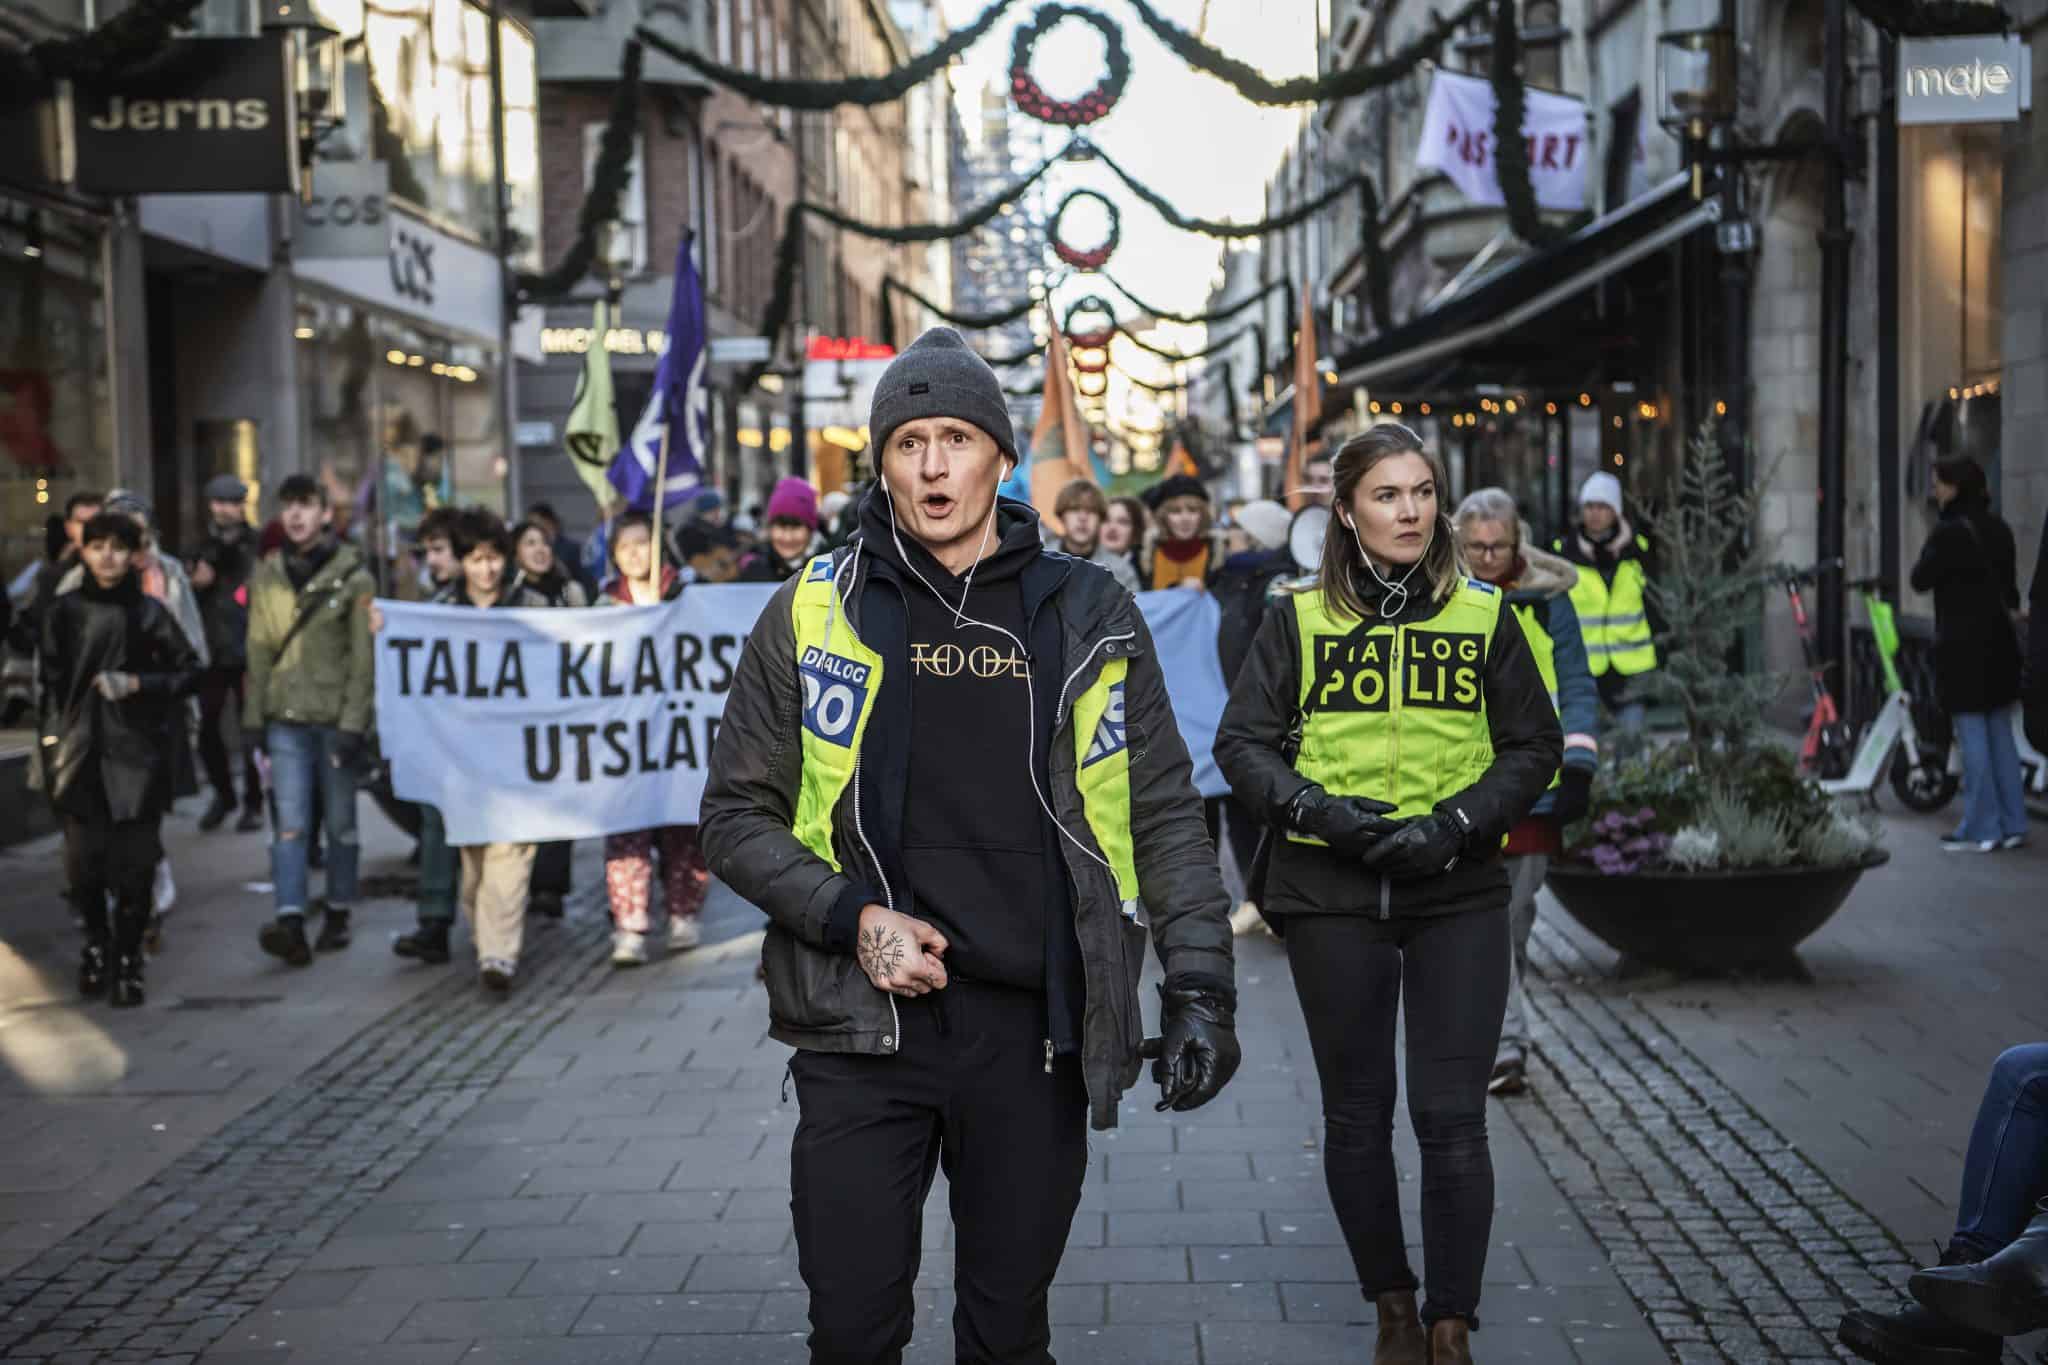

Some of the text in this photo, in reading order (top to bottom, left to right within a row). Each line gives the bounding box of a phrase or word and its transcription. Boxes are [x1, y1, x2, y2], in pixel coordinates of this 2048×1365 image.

[1905, 57, 2012, 101] maje
[90, 95, 269, 131] Jerns
[303, 194, 382, 227] COS
[541, 327, 645, 354] MICAEL
[387, 632, 750, 699] TALA KLARS
[803, 648, 867, 683] DIALOG
[910, 643, 1032, 678] TOOL
[1320, 664, 1478, 704] POLIS
